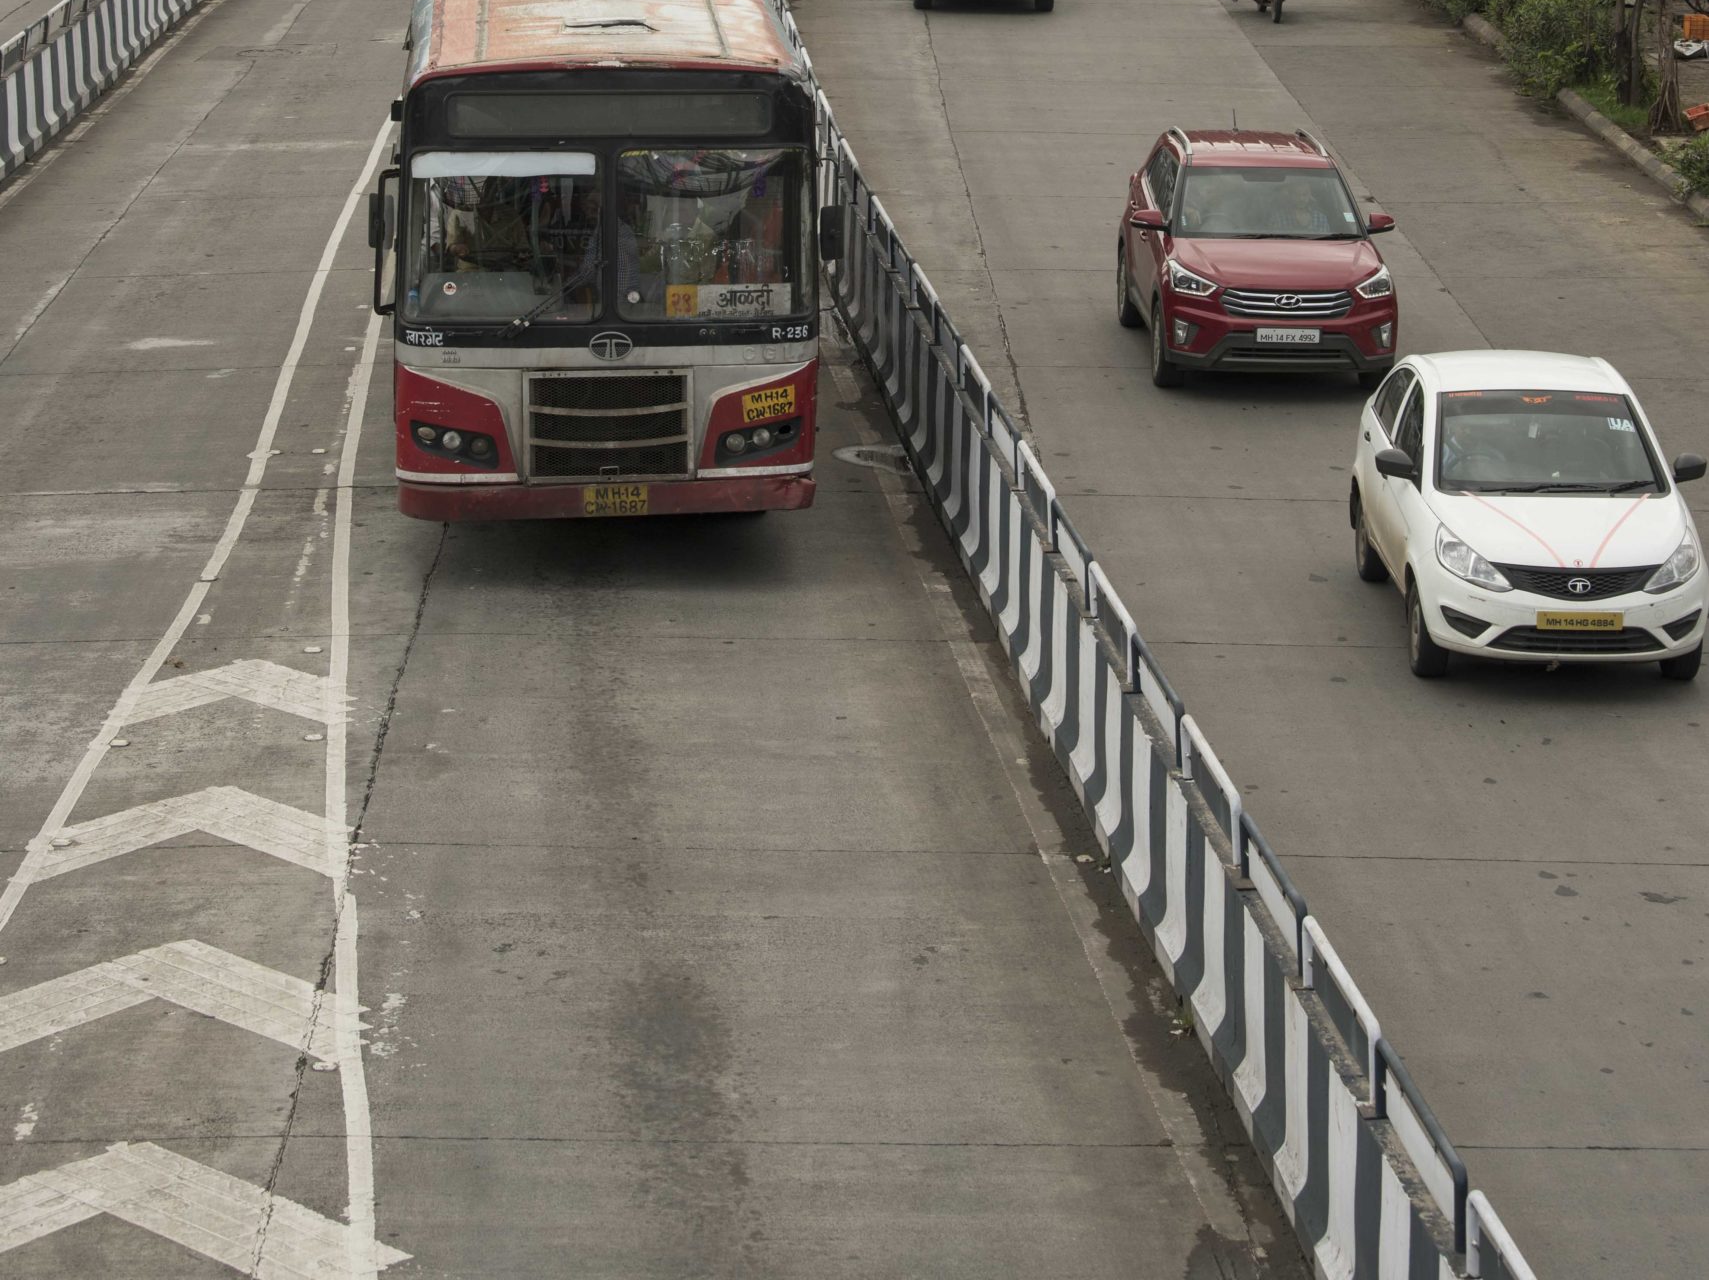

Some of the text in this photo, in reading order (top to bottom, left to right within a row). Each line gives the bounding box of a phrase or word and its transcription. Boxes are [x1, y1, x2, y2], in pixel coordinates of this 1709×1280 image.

[717, 284, 773, 308] आळंदी
[772, 325, 809, 340] R-236
[1260, 334, 1273, 342] MH
[1276, 334, 1284, 342] 14
[1286, 334, 1296, 342] FX
[1546, 618, 1561, 626] MH
[1564, 619, 1575, 627] 14
